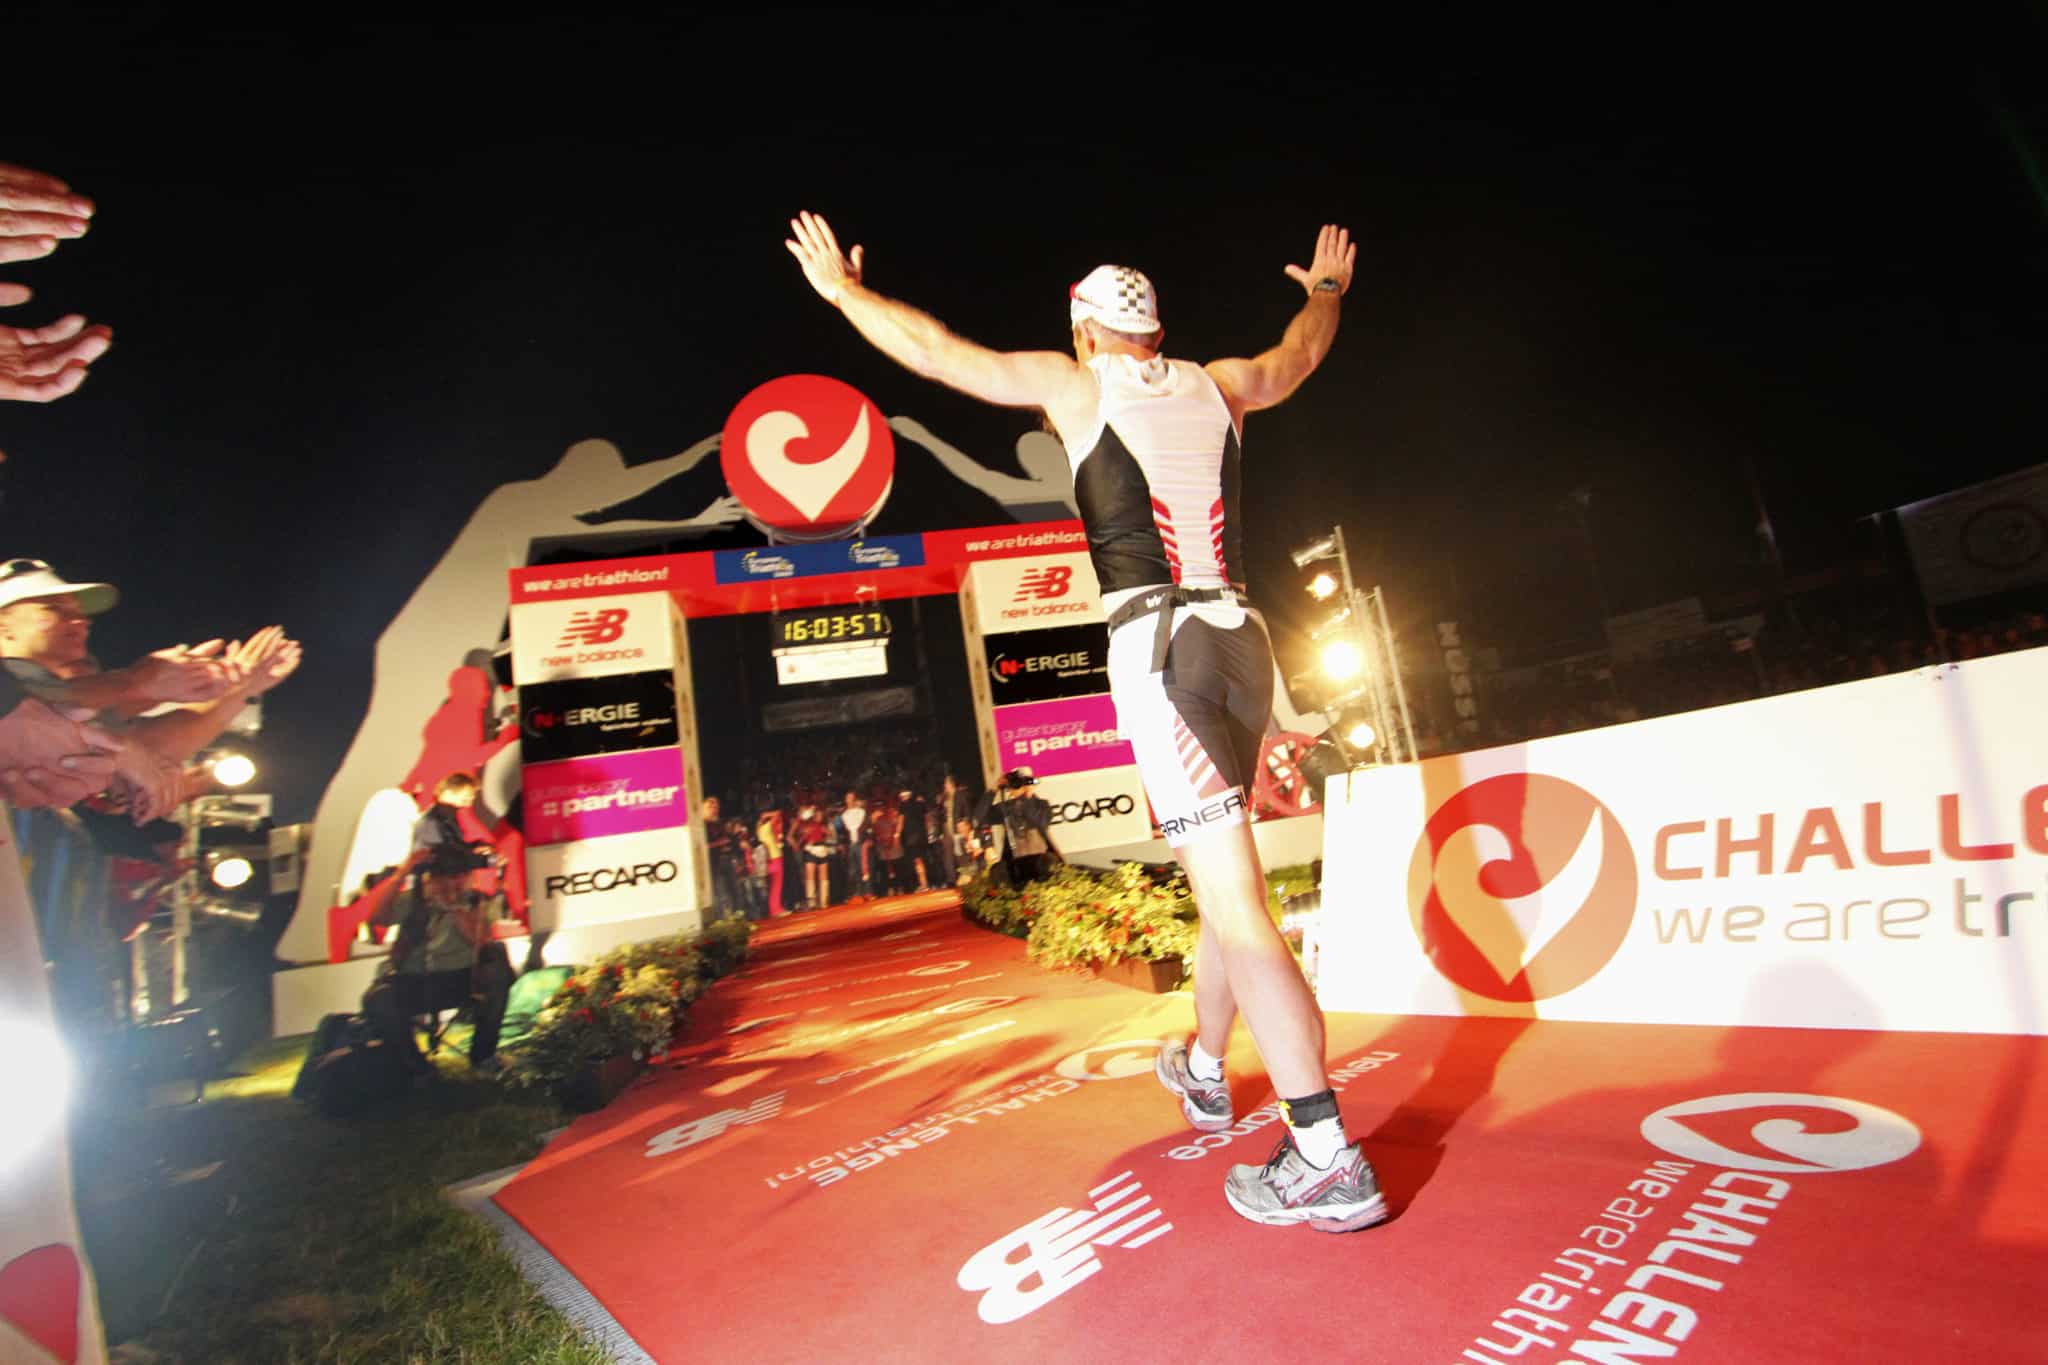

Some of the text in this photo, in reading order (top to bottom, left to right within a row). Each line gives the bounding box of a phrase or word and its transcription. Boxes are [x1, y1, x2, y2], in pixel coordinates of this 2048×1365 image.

[783, 612, 881, 641] 16:03:57
[999, 651, 1090, 676] N-ERGIE
[561, 785, 680, 818] partner
[1047, 794, 1135, 826] ECARO
[545, 860, 678, 899] RECARO
[1653, 877, 2048, 944] we are tr
[807, 1078, 1081, 1188] CHALLENGE
[1452, 1160, 1698, 1365] we are triathl
[1556, 1170, 1791, 1365] CHALLEN
